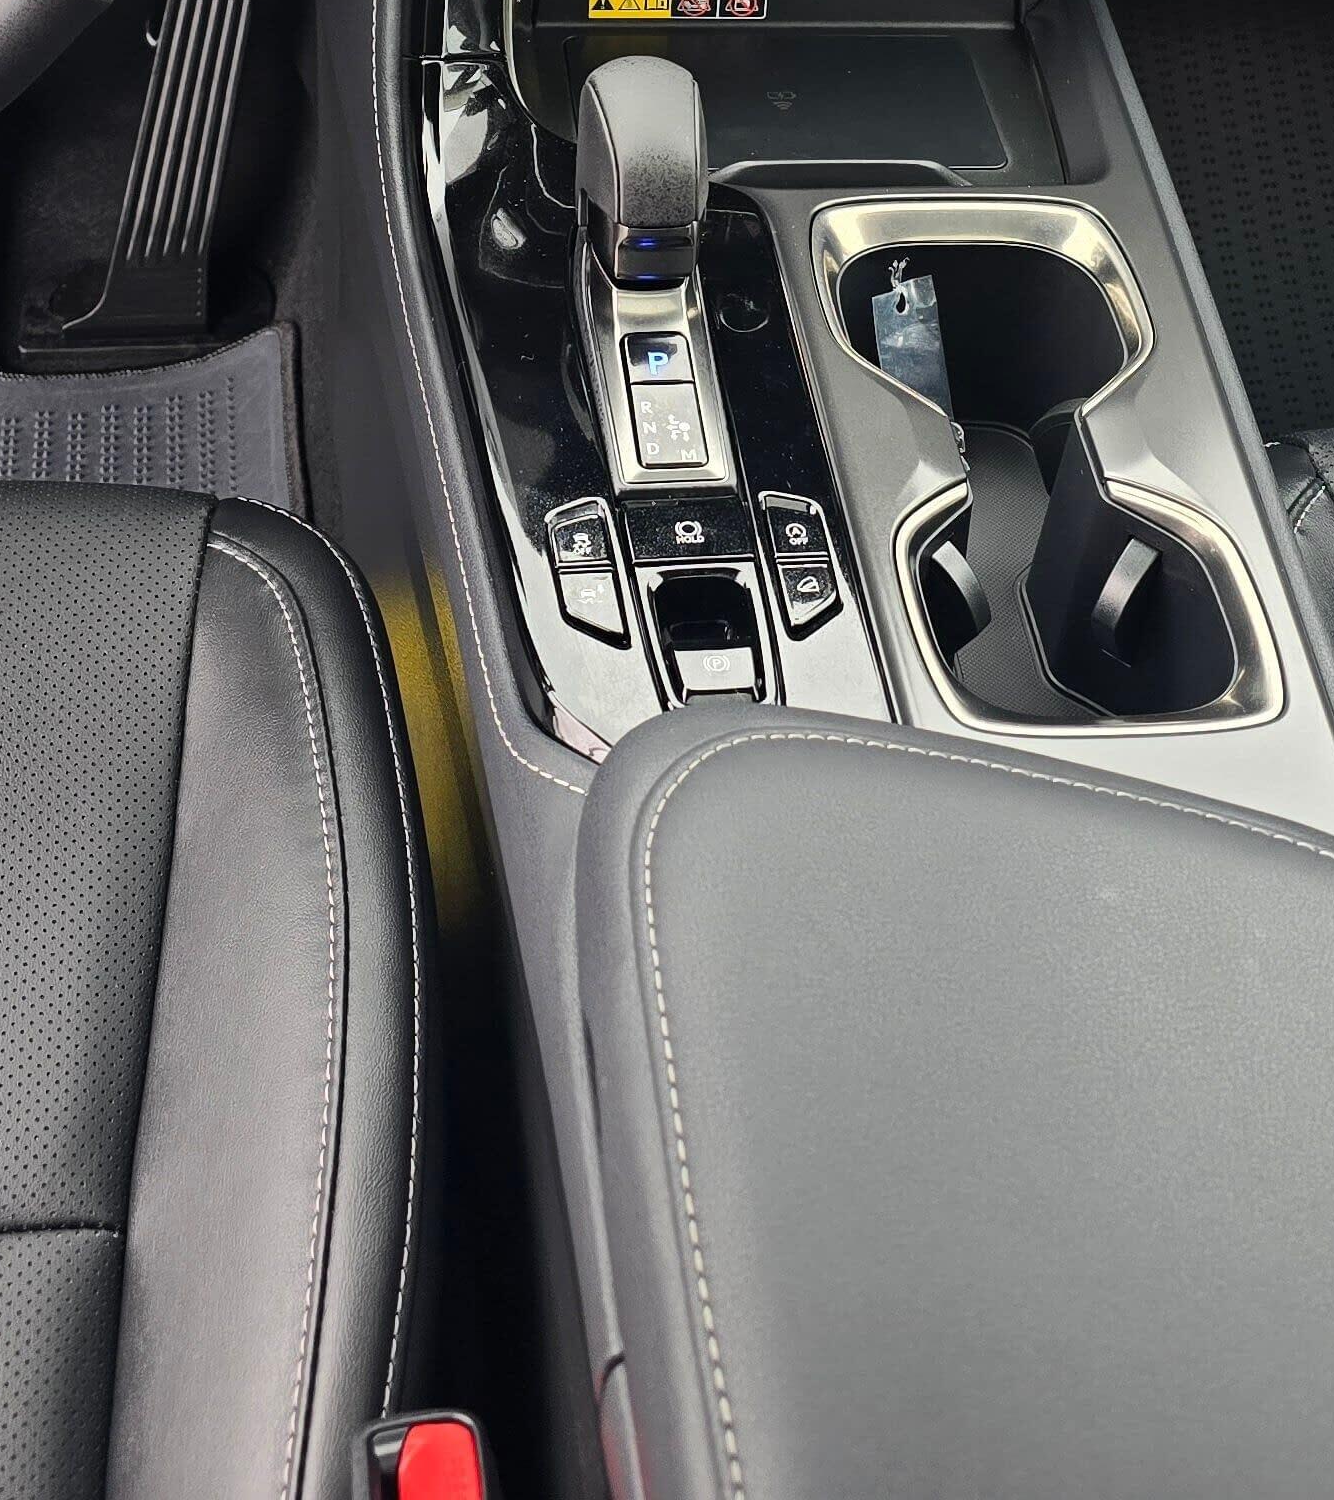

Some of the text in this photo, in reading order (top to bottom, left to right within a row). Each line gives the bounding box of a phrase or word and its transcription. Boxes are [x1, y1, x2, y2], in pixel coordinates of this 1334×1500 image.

[647, 351, 669, 376] P
[641, 401, 652, 414] R
[643, 422, 657, 434] N
[646, 443, 660, 456] D
[680, 449, 698, 462] M
[676, 534, 705, 544] HOLD
[789, 537, 809, 545] OFF
